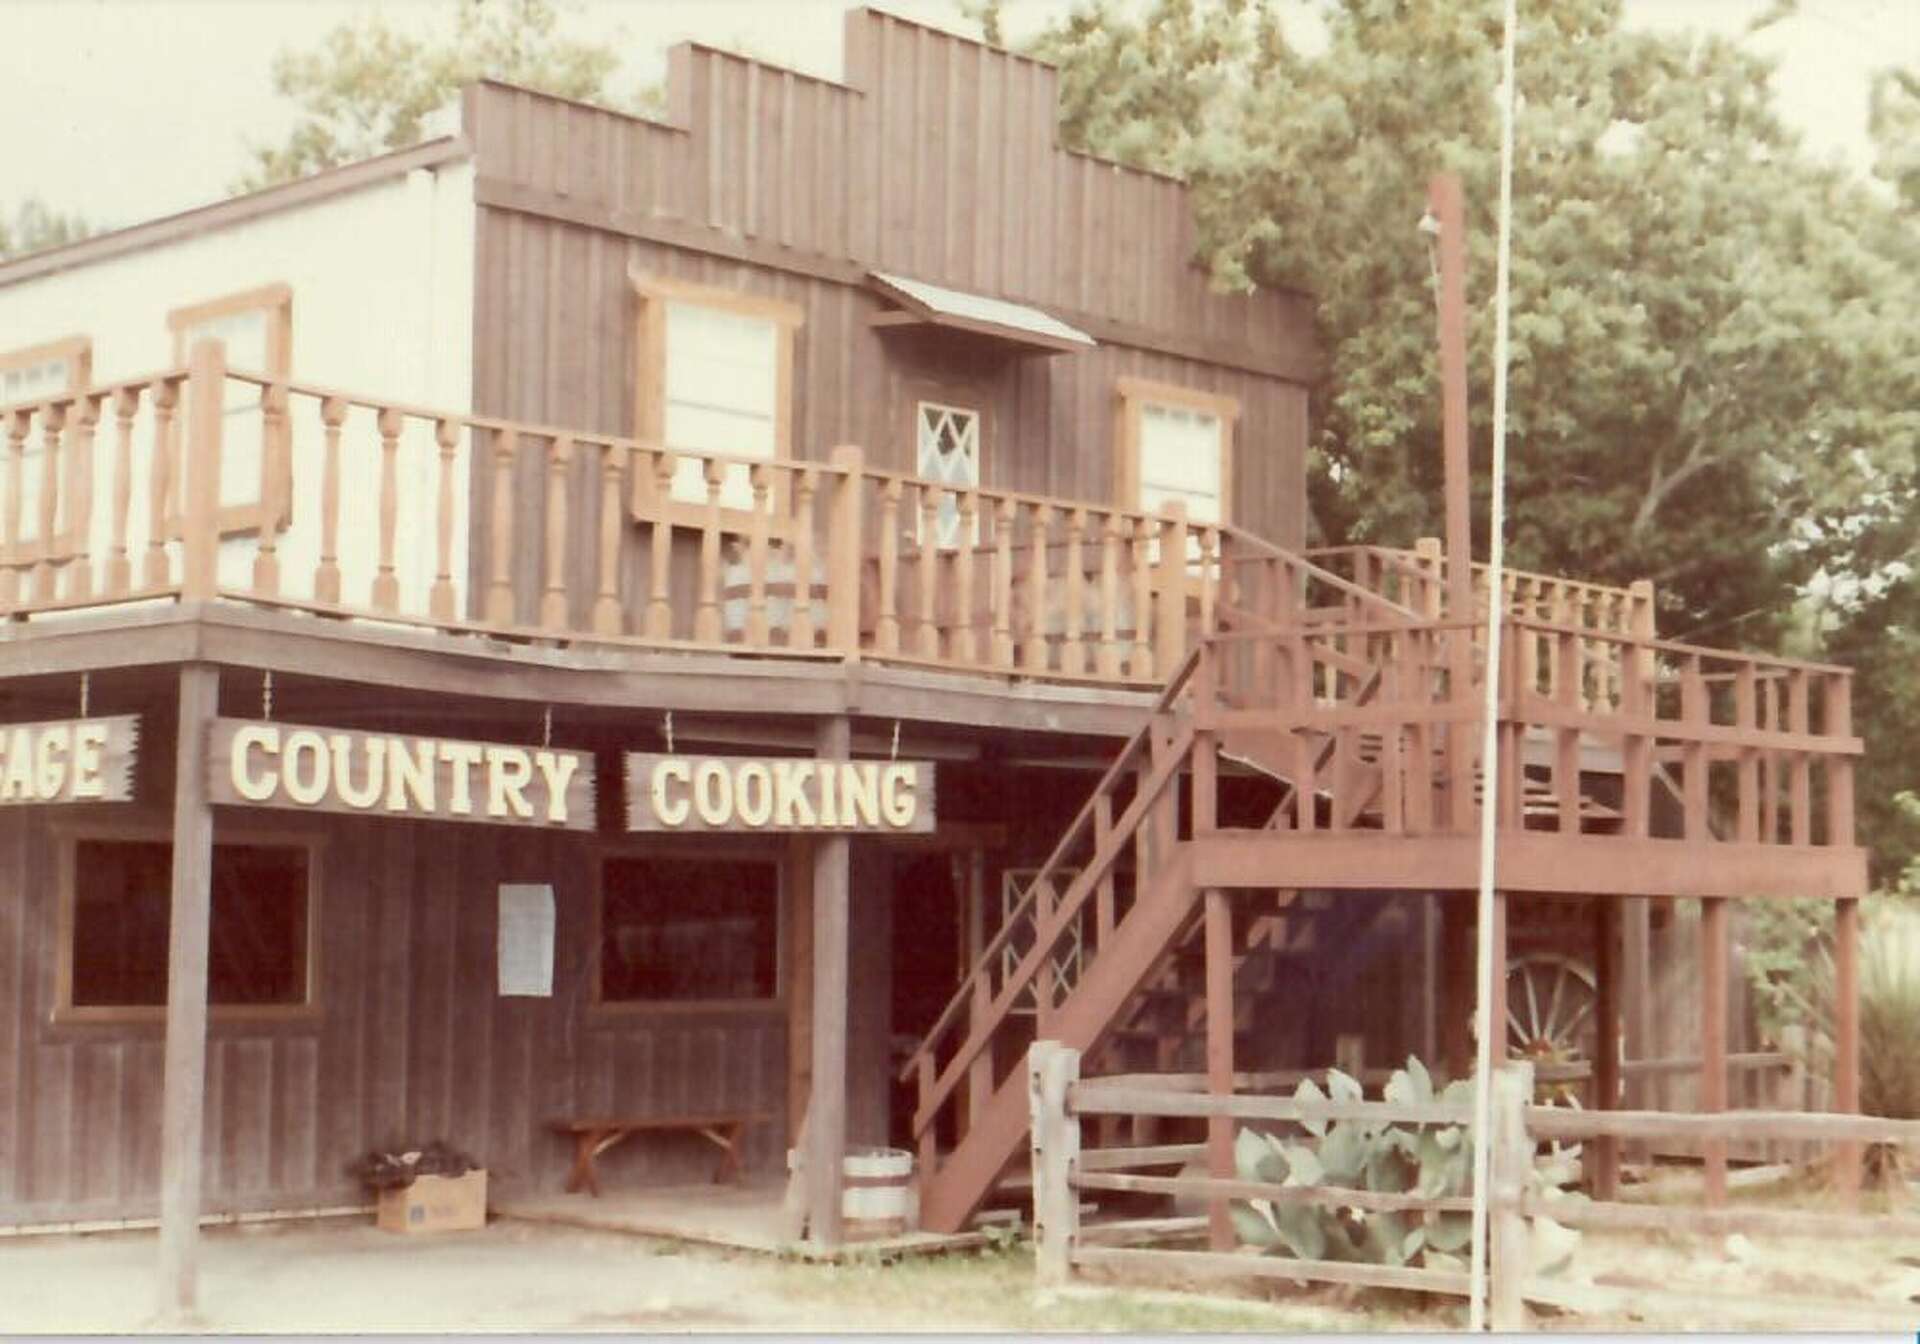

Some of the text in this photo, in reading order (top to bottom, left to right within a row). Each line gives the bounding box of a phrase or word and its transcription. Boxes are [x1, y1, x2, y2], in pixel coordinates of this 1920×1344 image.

[0, 725, 108, 800] AGE
[231, 726, 578, 821] COUNTRY
[652, 760, 917, 826] COOKING
